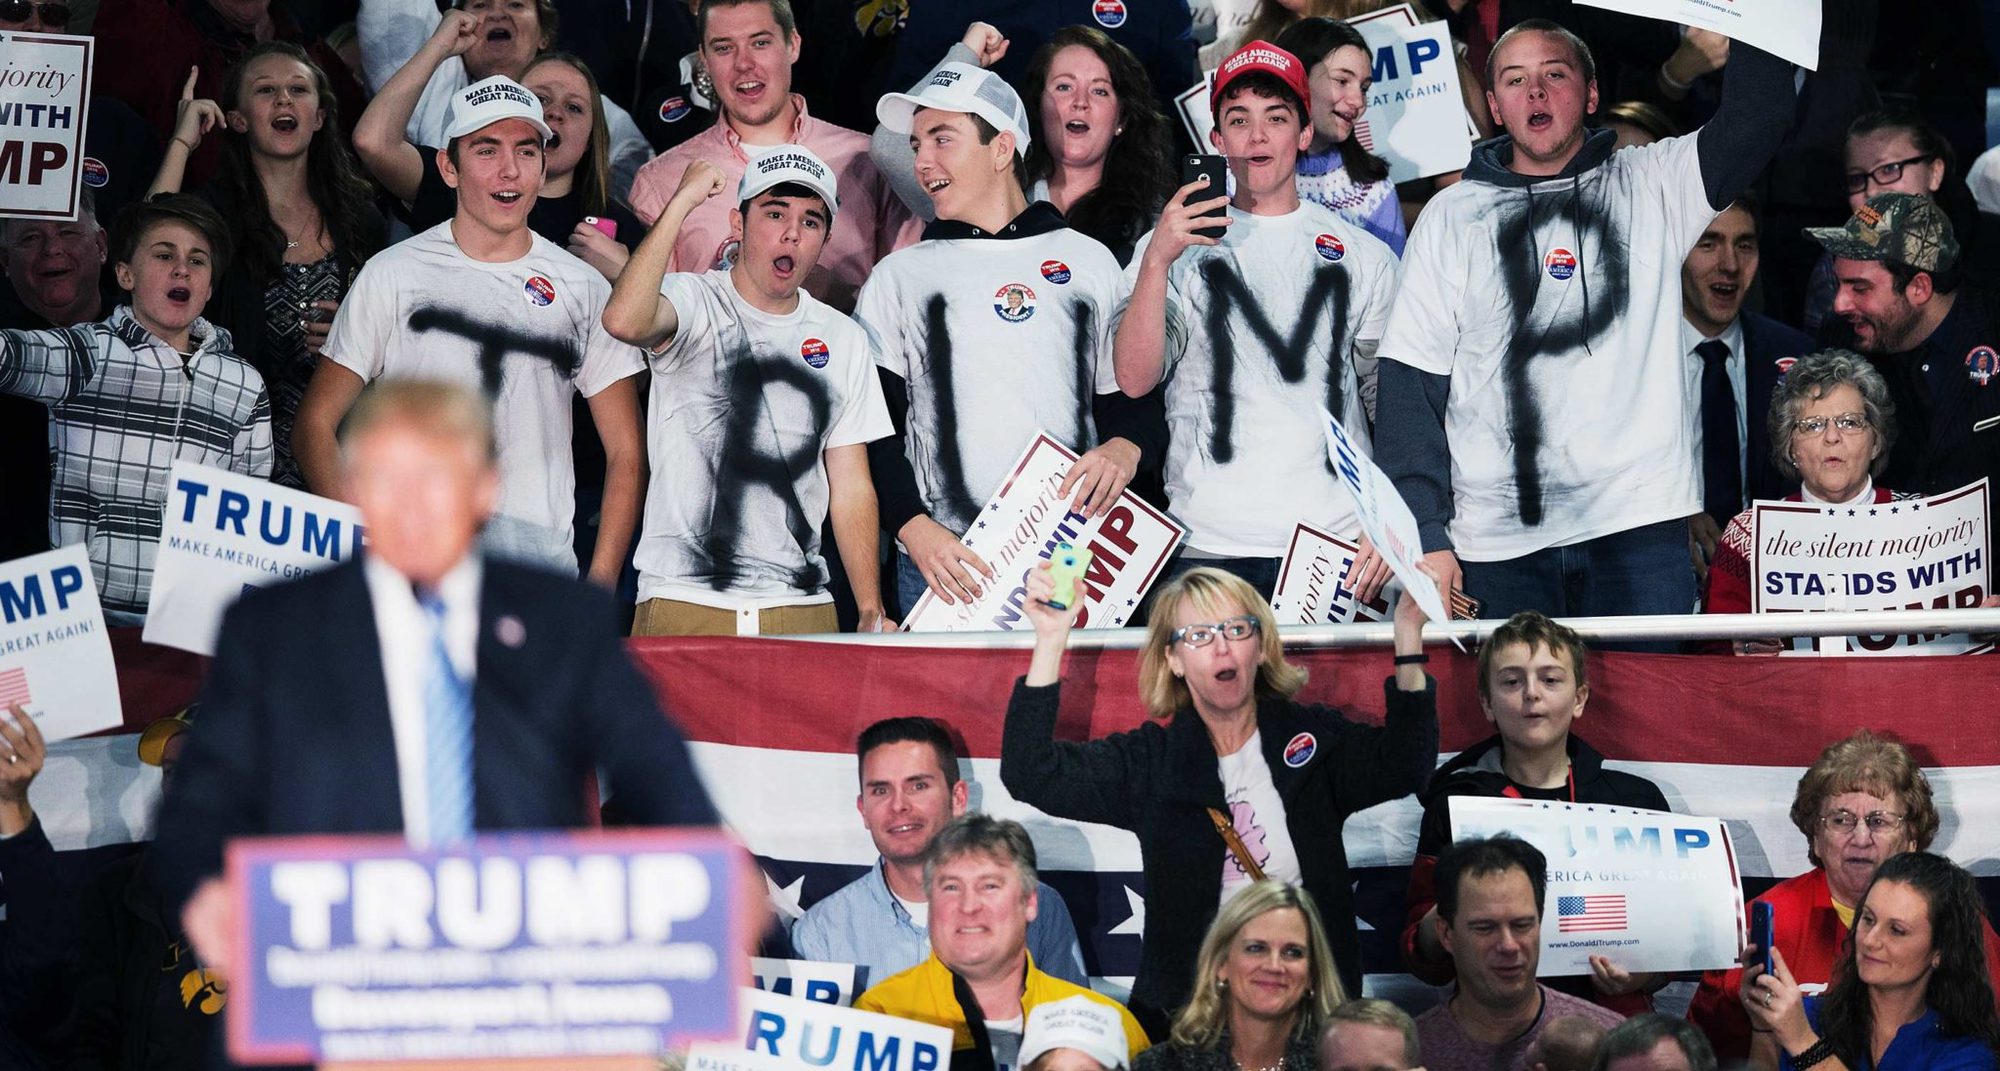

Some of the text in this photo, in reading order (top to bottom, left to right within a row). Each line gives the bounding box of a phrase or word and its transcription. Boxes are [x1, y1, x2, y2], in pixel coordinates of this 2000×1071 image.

[1224, 49, 1291, 71] MAKE AMERICA
[1227, 56, 1287, 73] GREAT AGAIN
[465, 86, 492, 102] MAKE
[471, 93, 532, 108] GREAT AGAIN
[1395, 82, 1447, 102] AGAIN!
[757, 154, 825, 176] MAKE AMERICA
[761, 162, 821, 180] GREAT AGAIN
[408, 305, 580, 402] T
[1498, 190, 1630, 526] P
[1198, 257, 1351, 479] M
[706, 356, 832, 594] R
[1765, 517, 1980, 561] the silent majority
[169, 536, 210, 556] MAKE
[214, 548, 279, 575] AMERICA
[1907, 548, 1982, 589] WITH
[47, 619, 95, 643] AGAIN!
[270, 854, 710, 949] TRUMP
[1548, 939, 1640, 948] www.DonaldJTrump.com
